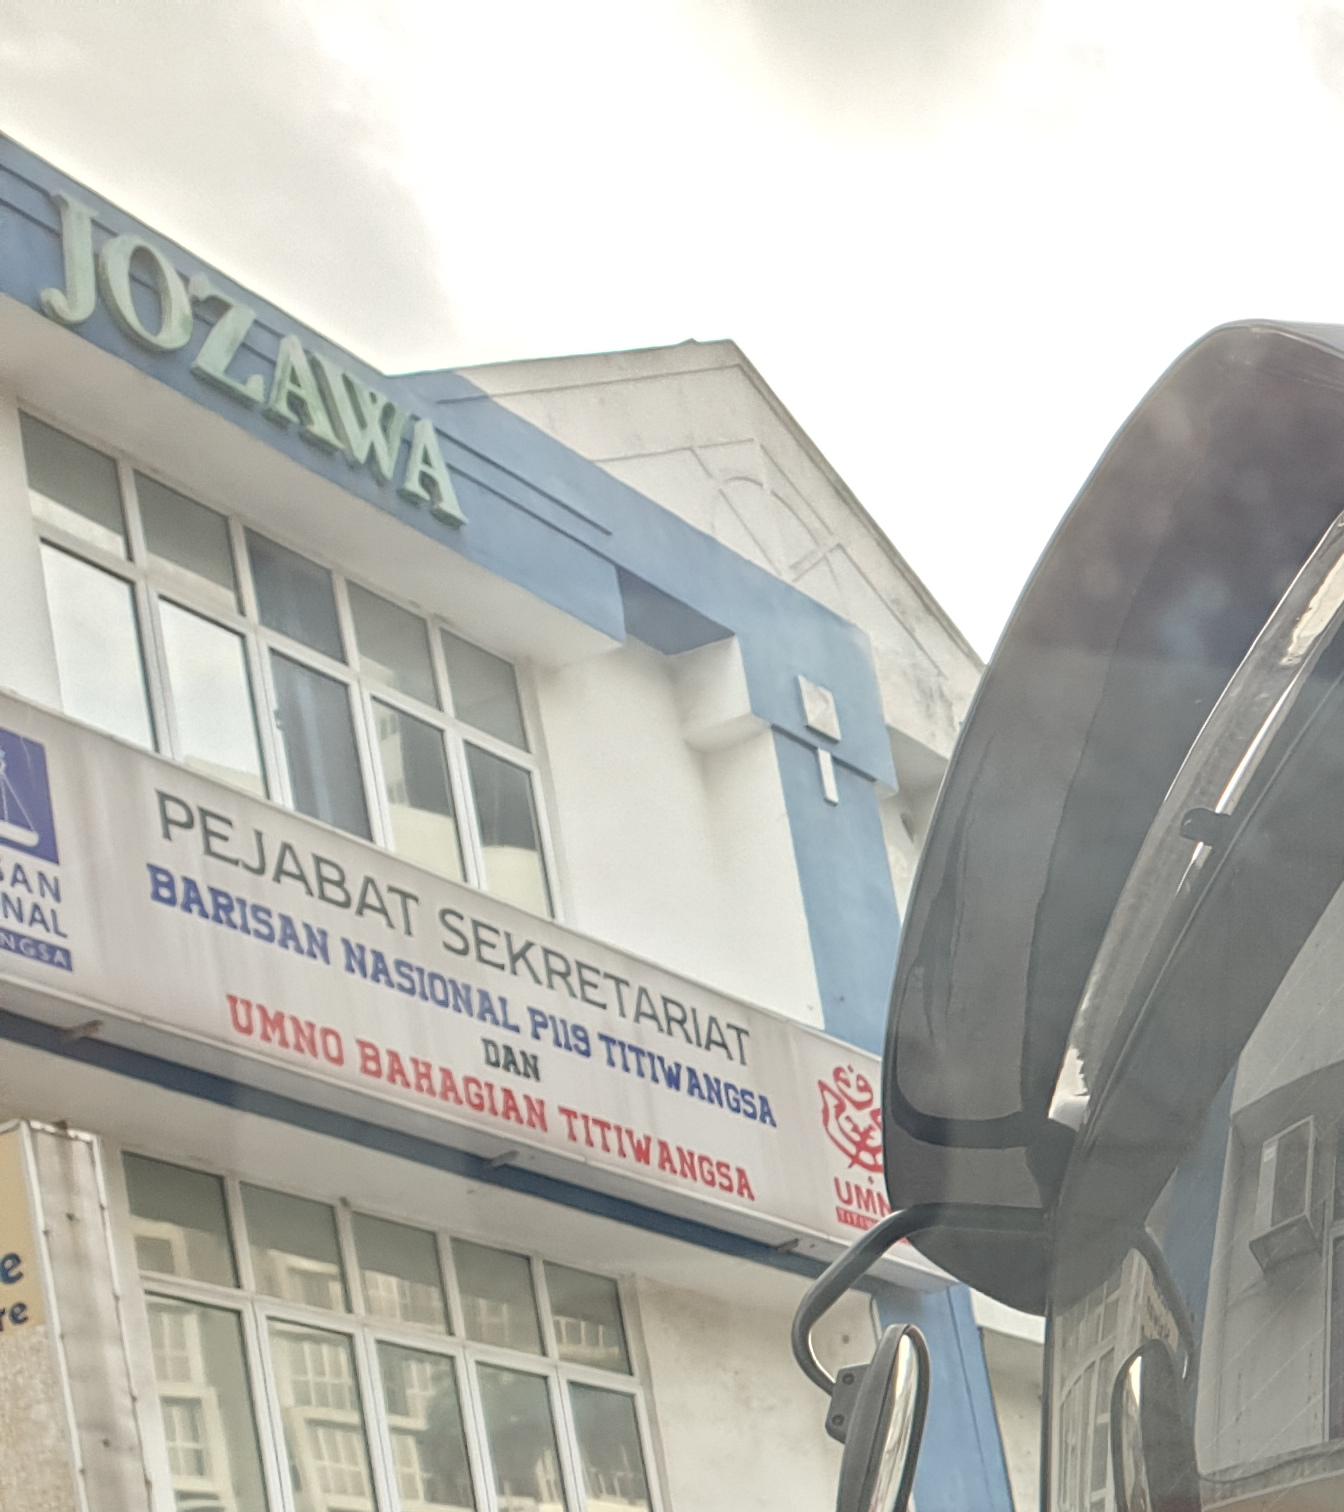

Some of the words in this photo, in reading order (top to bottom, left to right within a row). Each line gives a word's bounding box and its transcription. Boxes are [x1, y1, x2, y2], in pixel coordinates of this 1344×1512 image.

[40, 193, 468, 528] JOZAWA
[146, 863, 331, 965] BARISAN
[341, 937, 521, 1034] NASIONAL
[528, 1006, 591, 1058] P119
[599, 1033, 778, 1129] TITIWANGSA
[155, 789, 419, 937] PEJABAT
[438, 907, 750, 1066] SEKRETARIAT
[226, 993, 345, 1067] UMNO
[356, 1038, 548, 1133] BAHAGIAN
[558, 1105, 756, 1201] TITIWANGSA
[481, 1037, 541, 1083] DAN
[834, 1177, 893, 1218] UMN
